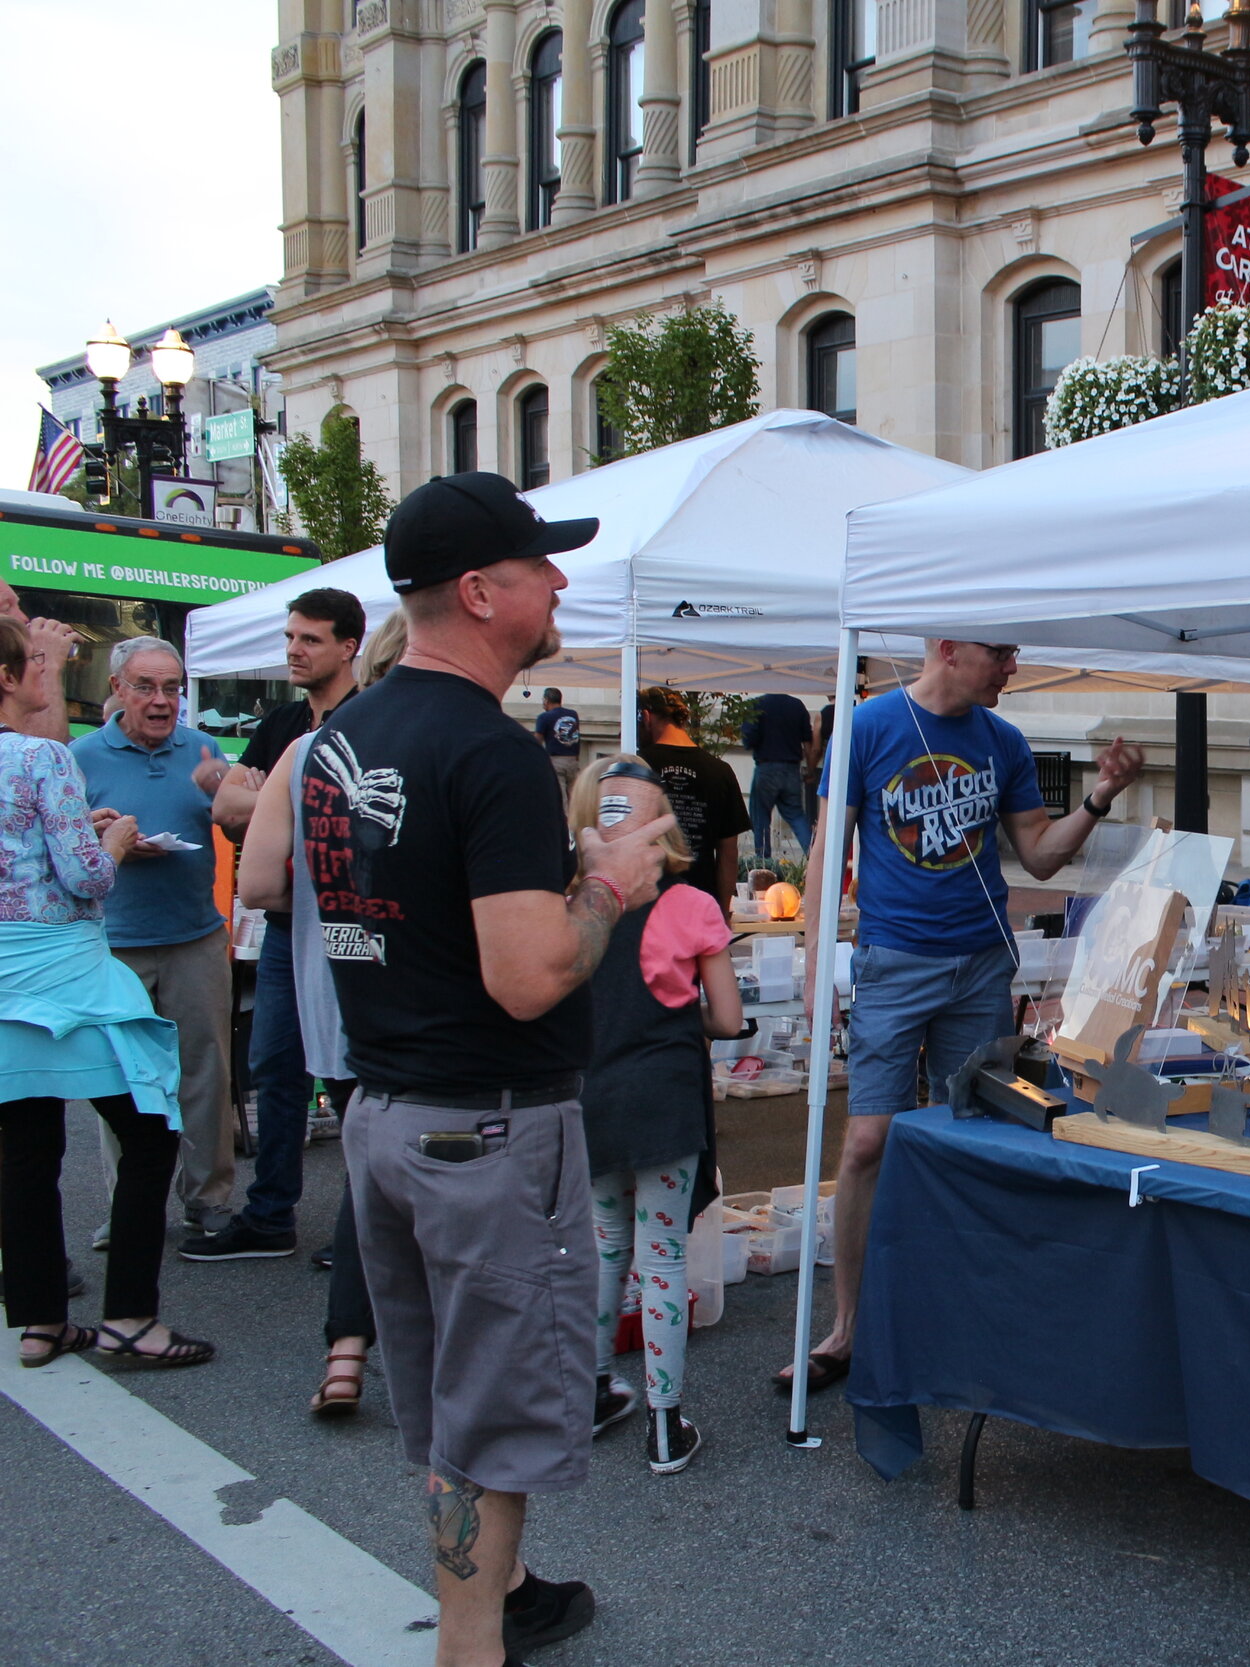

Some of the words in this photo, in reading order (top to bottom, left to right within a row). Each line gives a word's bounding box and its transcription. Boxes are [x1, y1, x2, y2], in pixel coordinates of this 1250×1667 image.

[209, 420, 238, 442] Market
[155, 510, 213, 526] OneEighty
[10, 554, 77, 576] FOLLOW
[83, 562, 106, 579] ME
[110, 565, 273, 594] @BUEHLERSFOODTRU
[882, 756, 998, 826] Mumford
[921, 812, 945, 857] &
